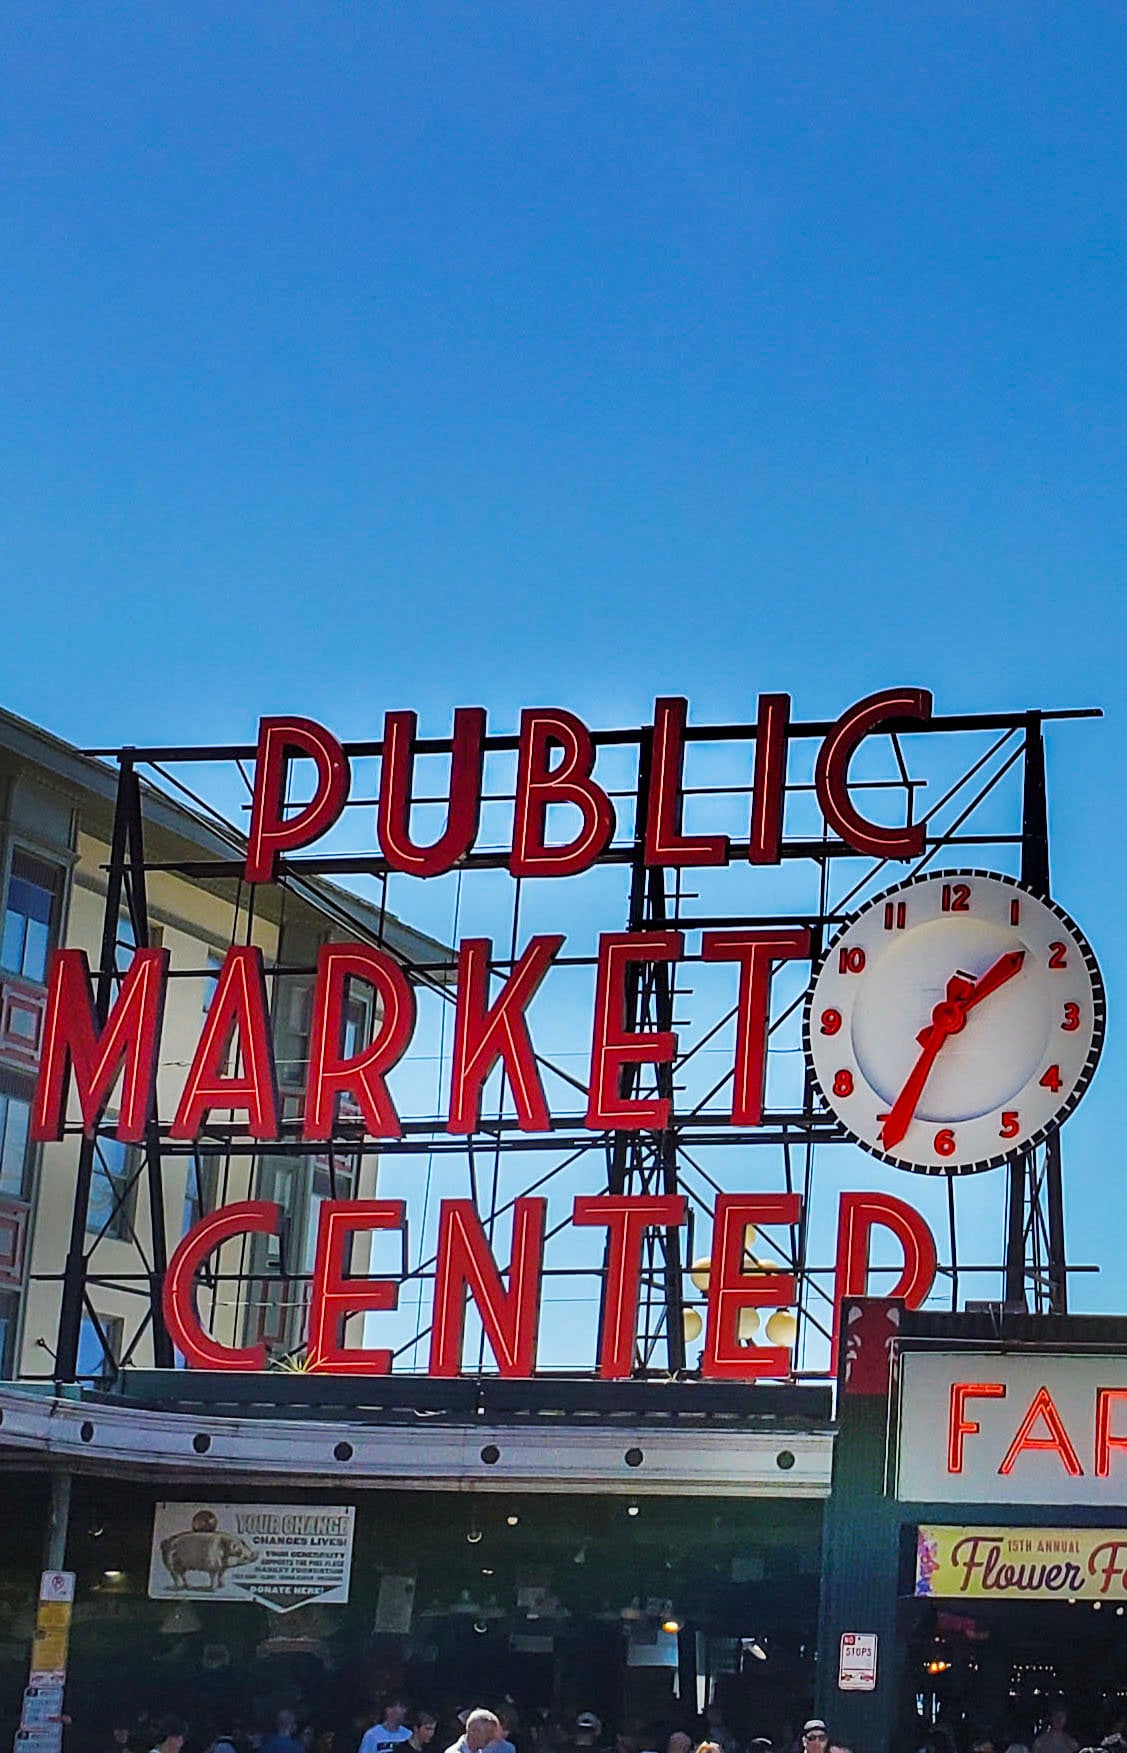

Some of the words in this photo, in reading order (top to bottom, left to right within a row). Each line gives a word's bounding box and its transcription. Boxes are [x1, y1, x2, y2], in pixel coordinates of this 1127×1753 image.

[246, 688, 932, 883] PUBLIC
[942, 884, 971, 911] 12
[884, 902, 907, 930] 11
[1011, 899, 1020, 926] 1
[839, 947, 866, 974] 10
[1048, 942, 1067, 969] 2
[820, 1008, 842, 1036] 9
[1060, 1002, 1081, 1031] 3
[32, 929, 811, 1142] MARKET
[832, 1069, 854, 1097] 8
[1039, 1065, 1063, 1093] 4
[999, 1112, 1019, 1138] 5
[934, 1129, 956, 1156] 6
[236, 1514, 281, 1534] YOUR
[282, 1515, 349, 1536] CHANGE
[253, 1536, 308, 1546] CHANGES
[1008, 1540, 1032, 1553] 15TH
[1036, 1540, 1080, 1554] ANNUAL
[951, 1536, 1085, 1592] Flower
[250, 1585, 291, 1595] DONATE
[846, 1647, 872, 1657] STOPS
